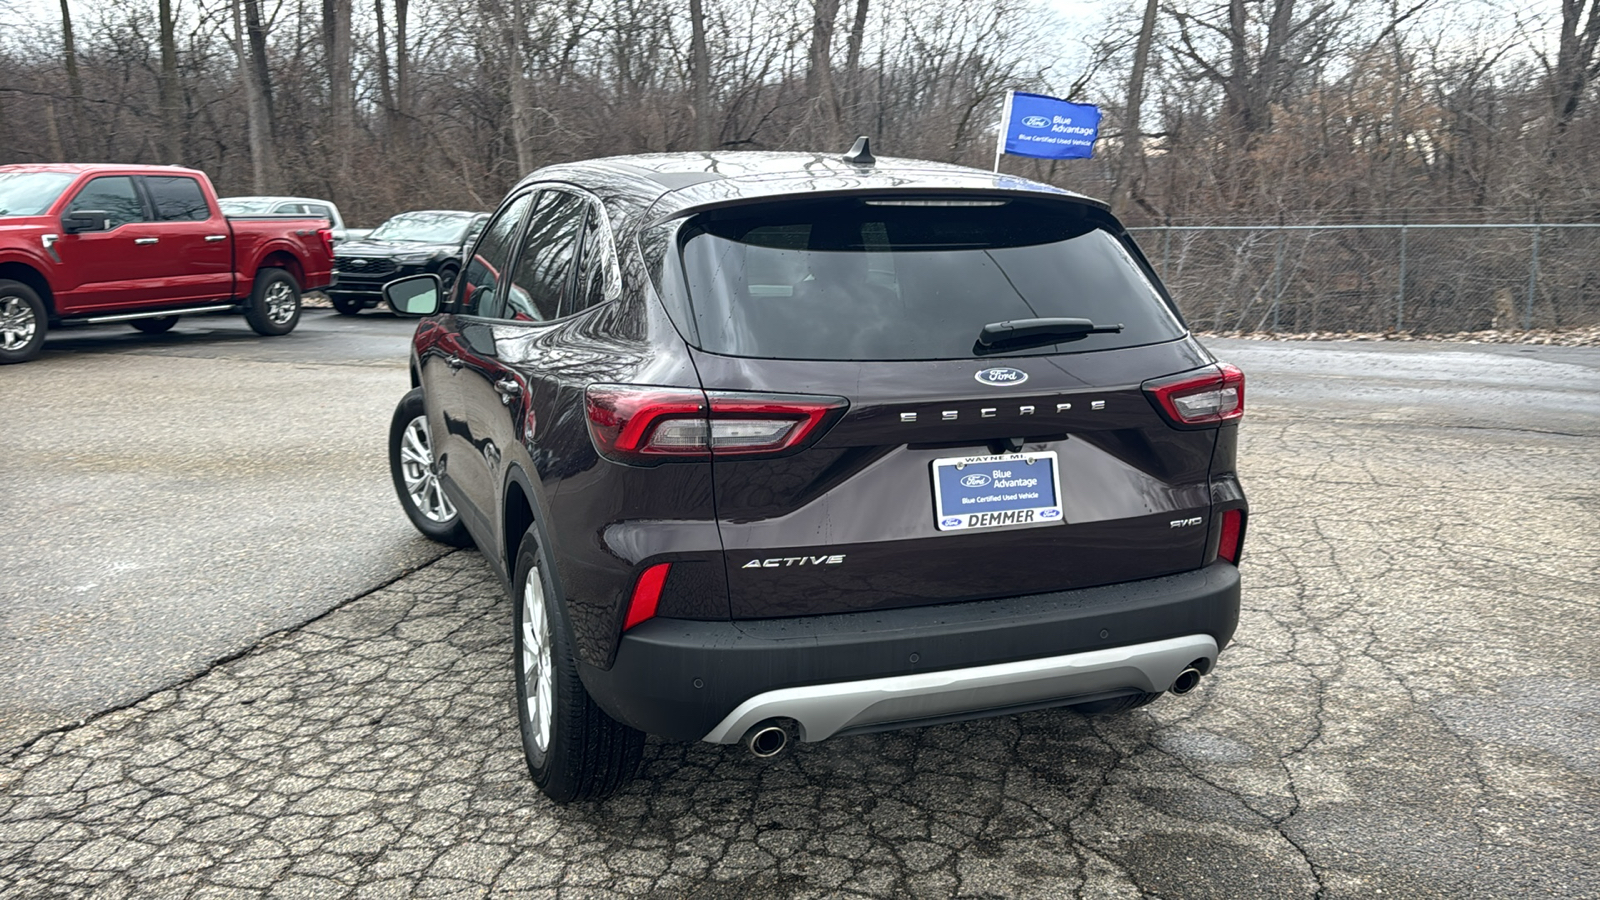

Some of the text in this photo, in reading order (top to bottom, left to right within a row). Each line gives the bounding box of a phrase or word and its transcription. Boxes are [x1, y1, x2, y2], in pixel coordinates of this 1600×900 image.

[1028, 118, 1046, 126] Ford
[1053, 116, 1071, 124] Blue
[1051, 124, 1094, 136] Advantage
[1032, 135, 1056, 144] Certified
[989, 370, 1017, 381] Ford
[900, 400, 1105, 422] ESCAPE
[993, 470, 1012, 479] Blue
[966, 475, 985, 485] Ford
[994, 478, 1038, 488] Advantage
[976, 495, 1001, 503] Certified
[968, 510, 1034, 527] DEMMER
[742, 554, 846, 568] ACTIVE
